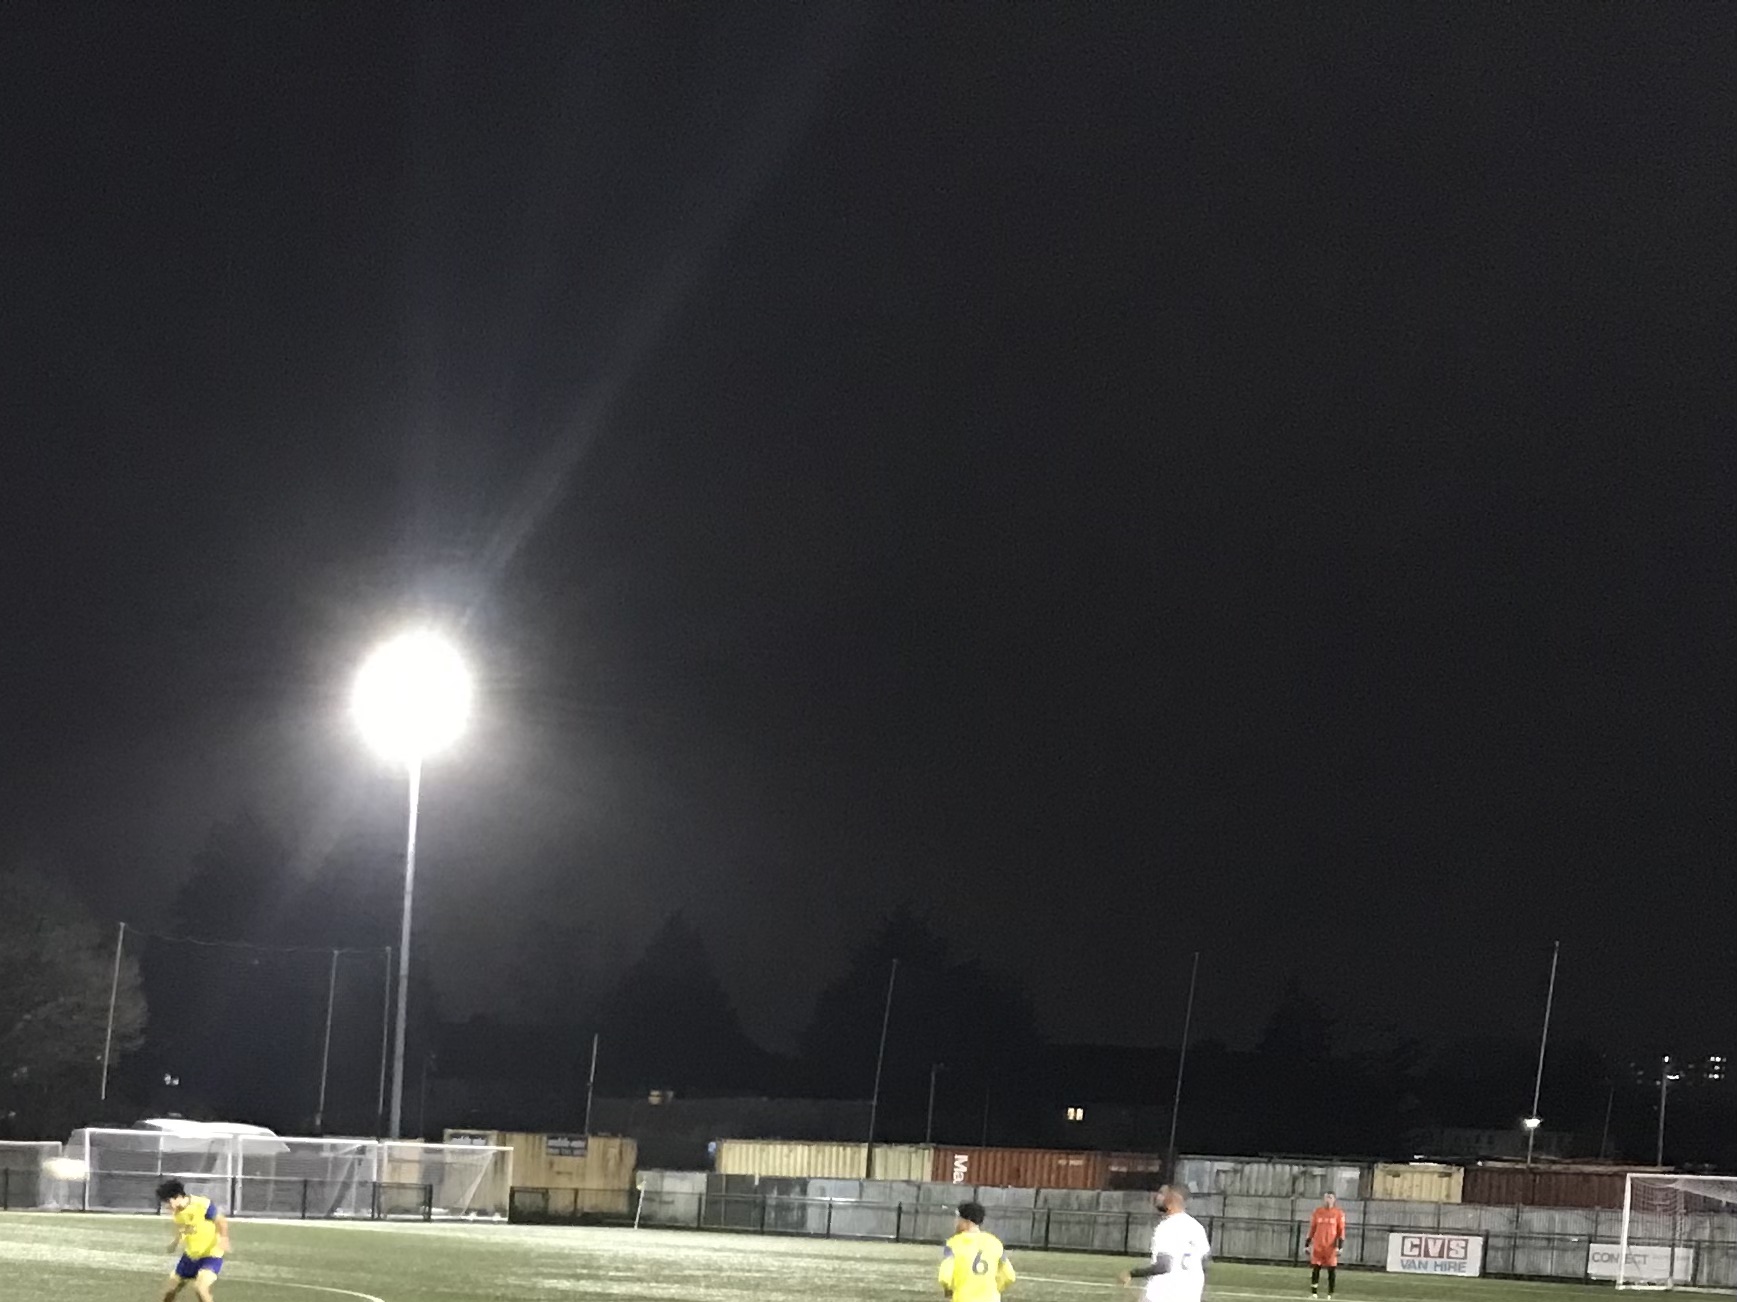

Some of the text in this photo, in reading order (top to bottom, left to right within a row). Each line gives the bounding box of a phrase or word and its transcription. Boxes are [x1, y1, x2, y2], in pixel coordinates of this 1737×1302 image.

[1403, 1237, 1467, 1259] CVS
[972, 1251, 989, 1275] 6
[1400, 1259, 1468, 1274] VAN HIRE
[1591, 1251, 1649, 1265] CONECT
